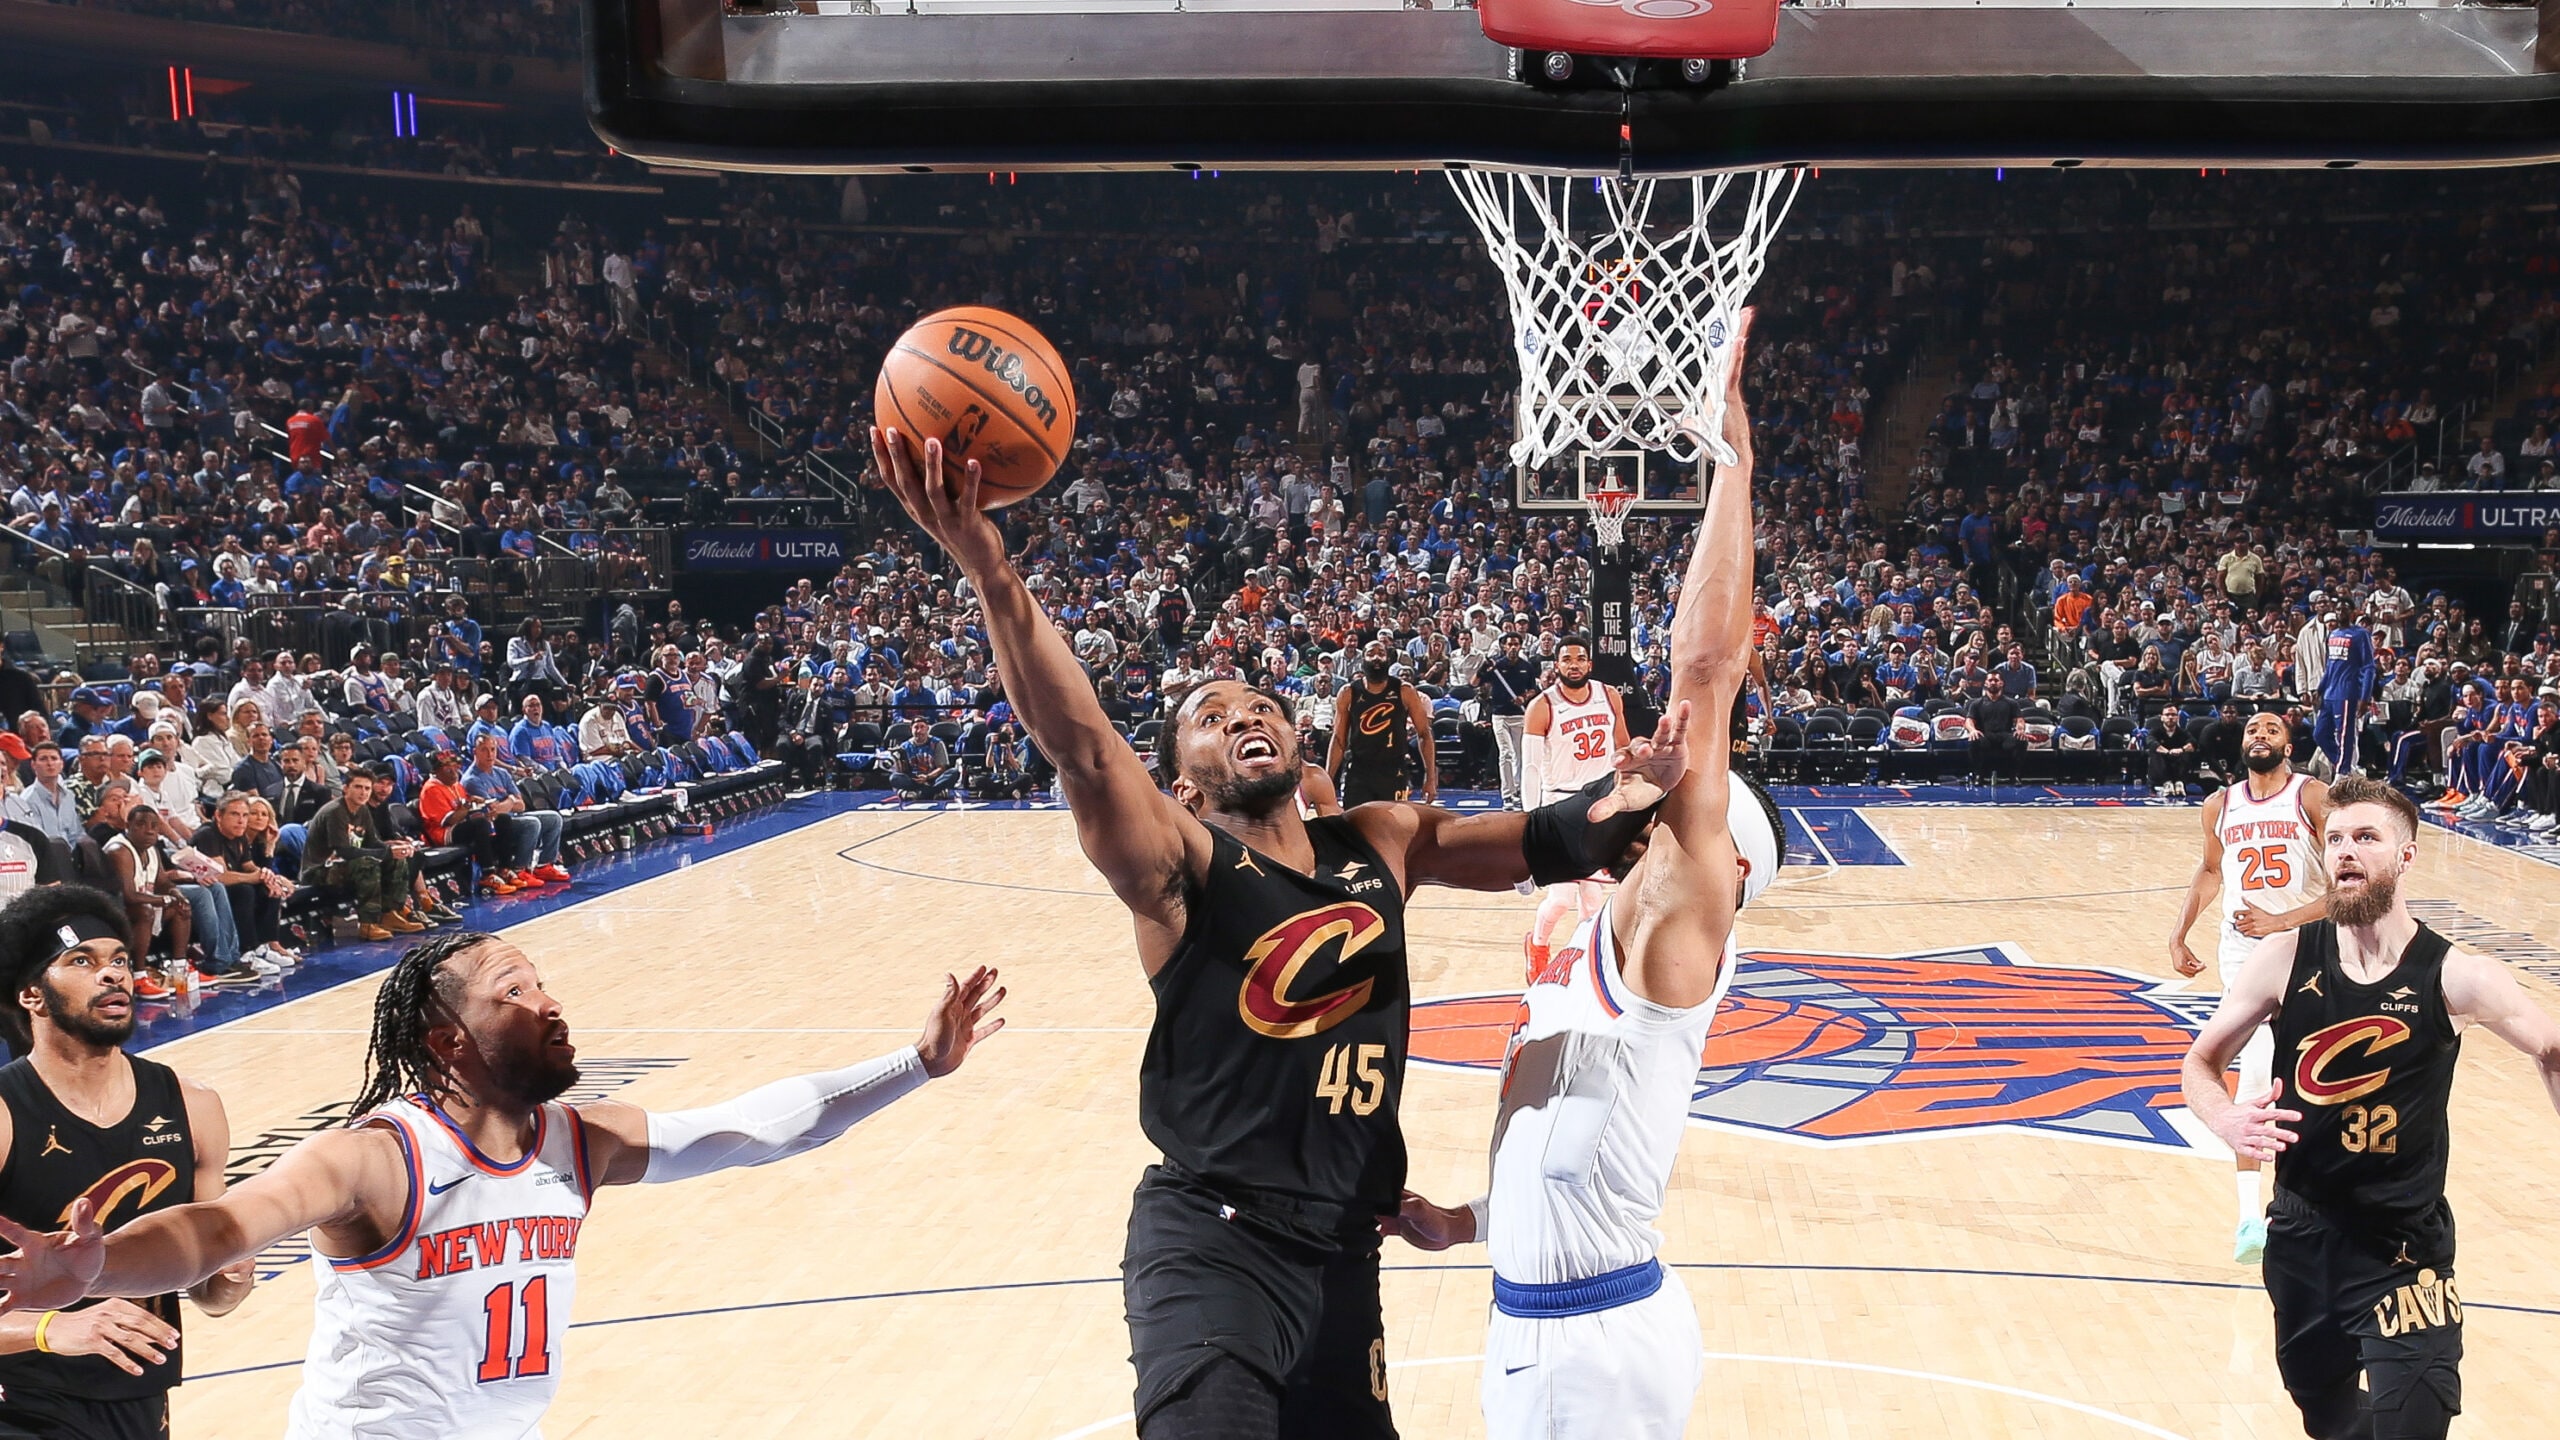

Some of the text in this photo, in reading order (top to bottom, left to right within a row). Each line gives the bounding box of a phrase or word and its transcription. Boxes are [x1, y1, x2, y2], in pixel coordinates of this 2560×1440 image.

[947, 326, 1057, 432] Wilson
[2375, 505, 2456, 528] Michelob
[687, 539, 840, 560] Michelob ULTRA
[1602, 602, 1622, 618] GET
[1602, 619, 1622, 635] THE
[1607, 636, 1627, 656] App
[1560, 714, 1611, 735] NEW YORK
[1386, 731, 1393, 748] 1
[1573, 729, 1606, 760] 32
[2224, 820, 2300, 846] NEW YORK
[2238, 844, 2291, 891] 25
[1238, 901, 1386, 1039] C
[2380, 1002, 2419, 1013] CLIFFS
[2294, 1015, 2411, 1106] C
[1315, 1043, 1386, 1116] 45
[142, 1133, 182, 1145] CLIFFS
[2341, 1104, 2397, 1154] 32
[416, 1219, 510, 1281] NEW
[2373, 1270, 2462, 1337] CAVS
[477, 1274, 550, 1384] 11
